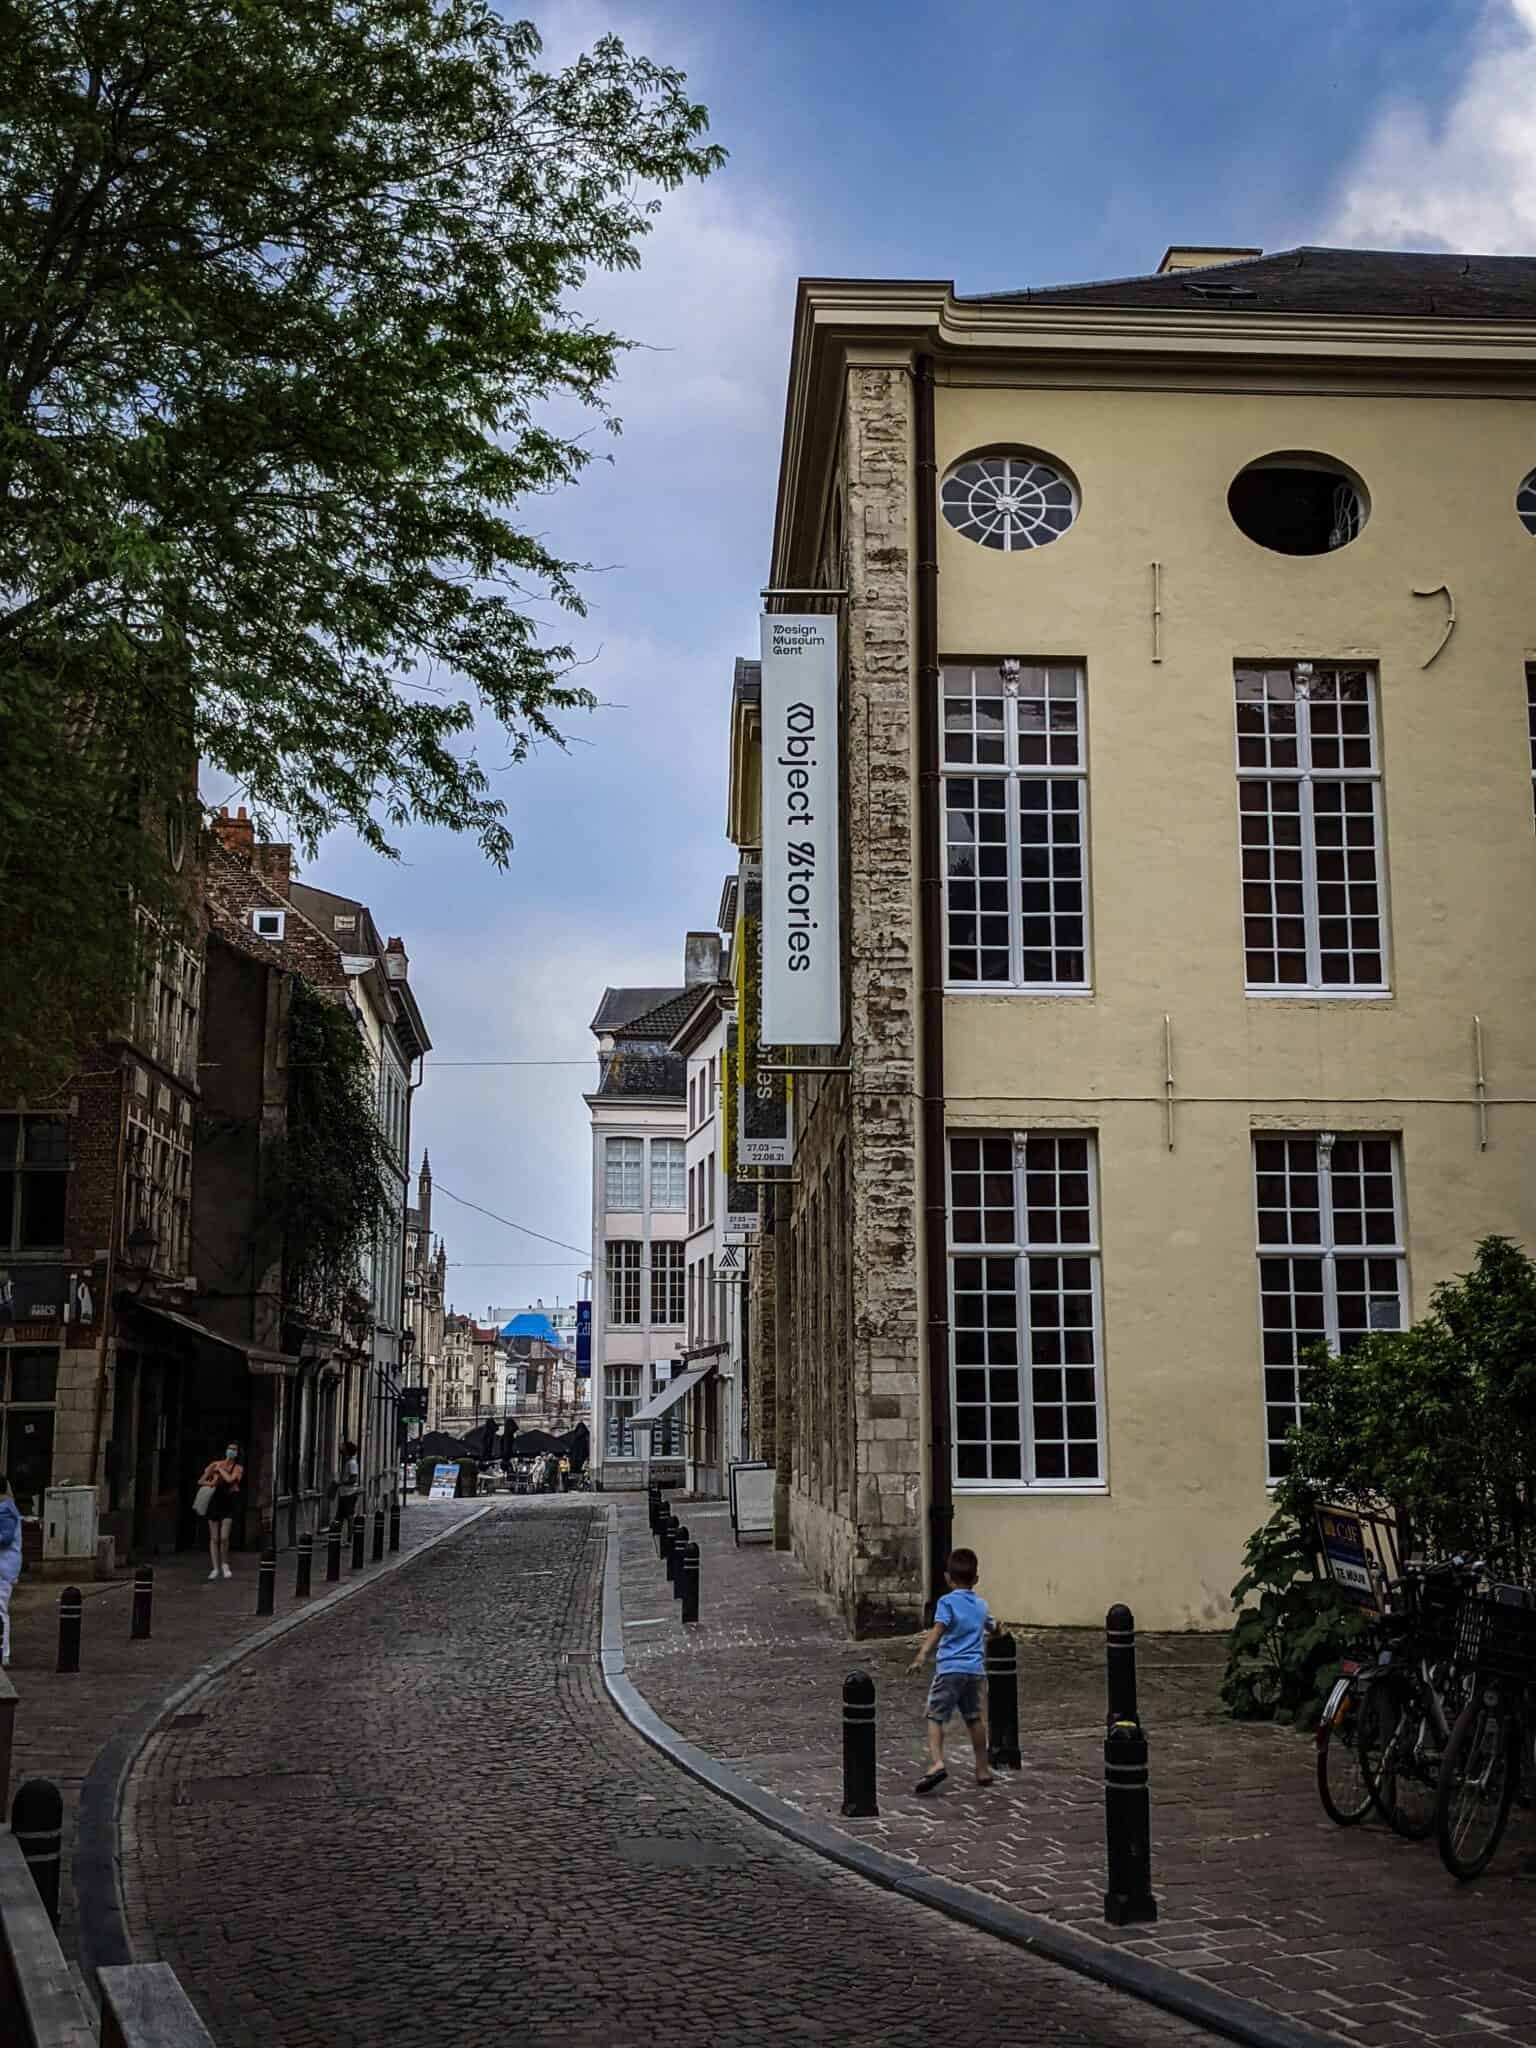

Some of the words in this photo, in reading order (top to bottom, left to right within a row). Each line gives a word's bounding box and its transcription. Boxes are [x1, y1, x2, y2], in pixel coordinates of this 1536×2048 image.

[772, 624, 817, 637] Design
[772, 636, 825, 646] Museum
[772, 646, 803, 656] Gent
[777, 702, 817, 826] Object
